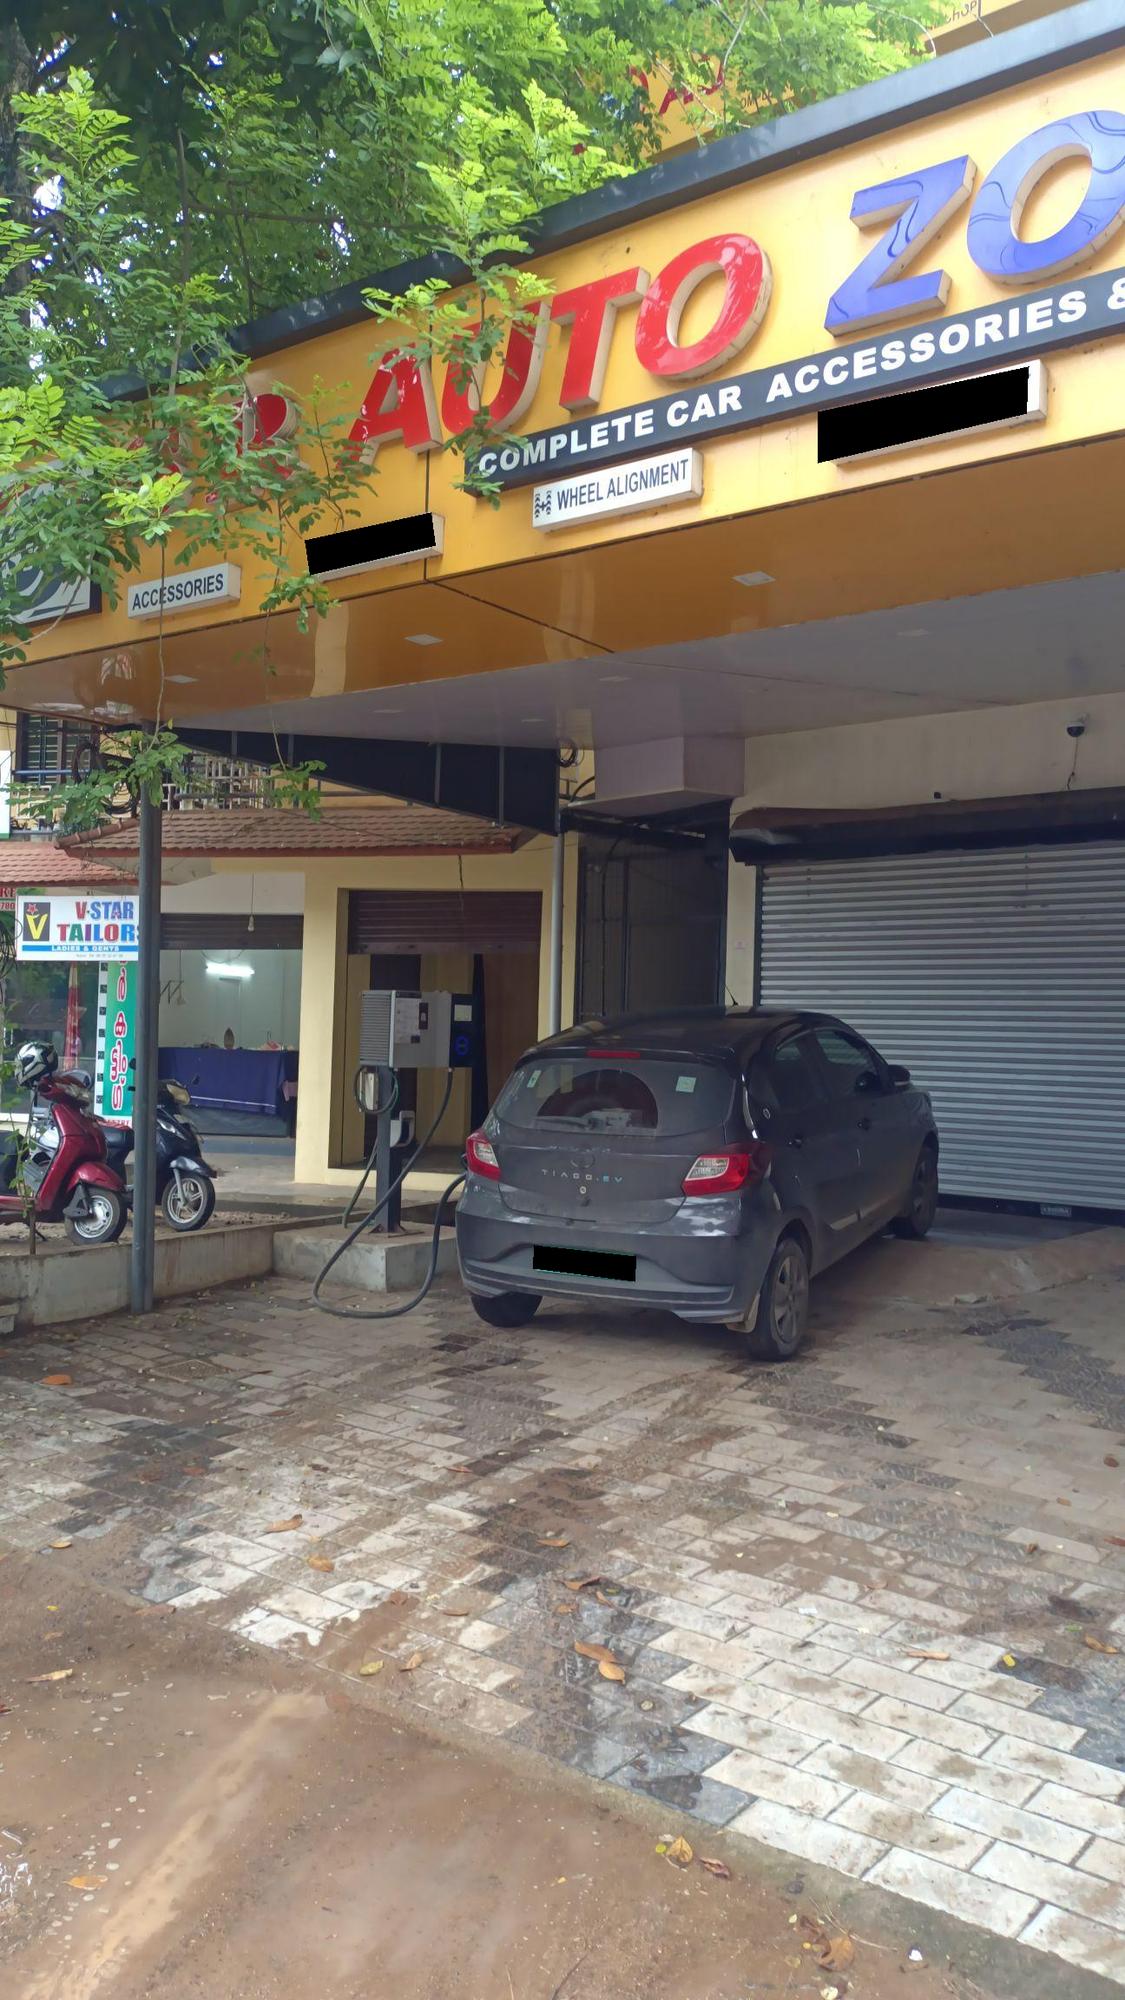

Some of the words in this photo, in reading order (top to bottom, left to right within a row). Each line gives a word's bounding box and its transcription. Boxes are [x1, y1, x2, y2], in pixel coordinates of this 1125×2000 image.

[337, 232, 771, 468] AUTO
[478, 409, 655, 478] COMPLETE
[666, 384, 742, 428] CAR
[765, 290, 1088, 403] ACCESSORIES
[557, 481, 604, 511] WHEEL
[607, 458, 690, 499] ALIGNMENT
[132, 573, 225, 611] ACCESSORIES
[57, 923, 139, 942] TAILOR
